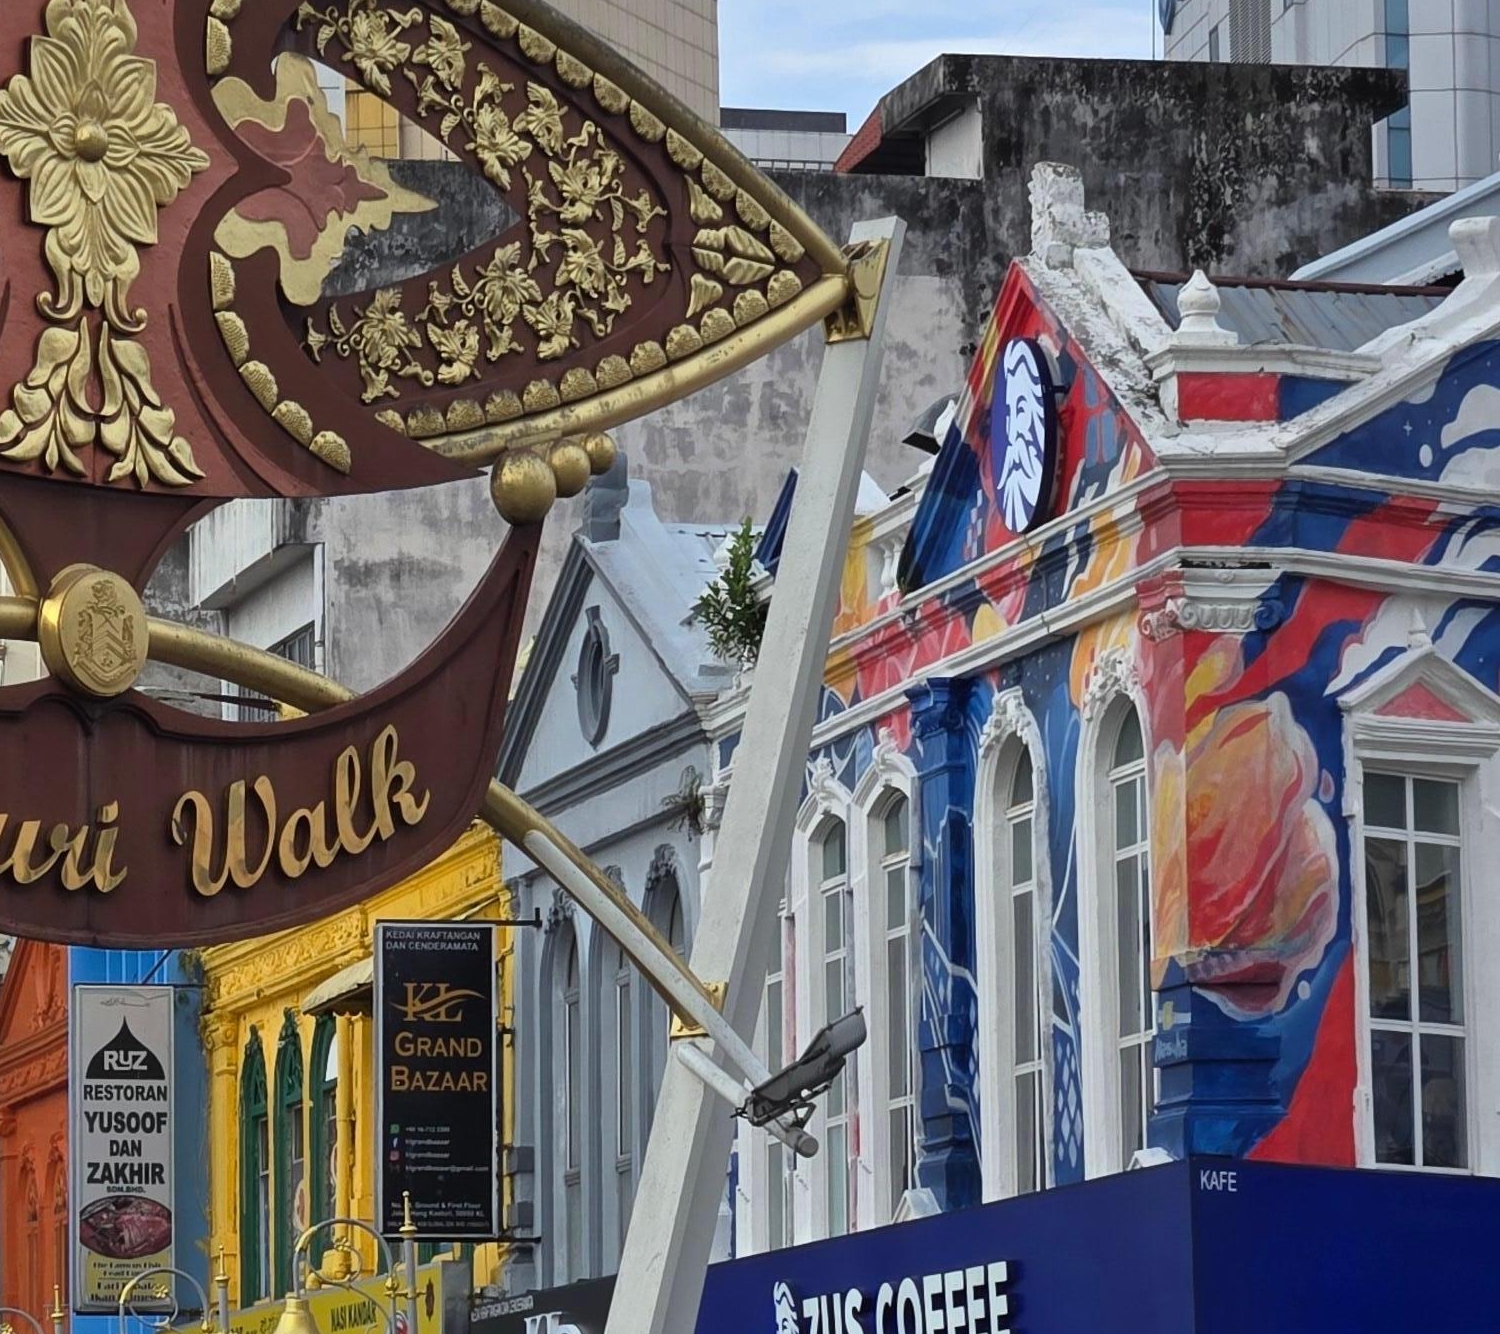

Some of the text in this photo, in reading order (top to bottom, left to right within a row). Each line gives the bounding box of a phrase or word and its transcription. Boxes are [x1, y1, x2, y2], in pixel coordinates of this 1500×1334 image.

[172, 724, 430, 896] Walk
[386, 931, 480, 940] KEDAI KRAFTANGAN
[386, 942, 478, 951] DAN CENDERAMATA
[83, 1085, 167, 1101] RESTORAN
[84, 1111, 167, 1133] YUSOOF
[109, 1139, 141, 1156] DAN
[87, 1162, 165, 1184] ZAKHIR
[1200, 1170, 1237, 1192] KAFE
